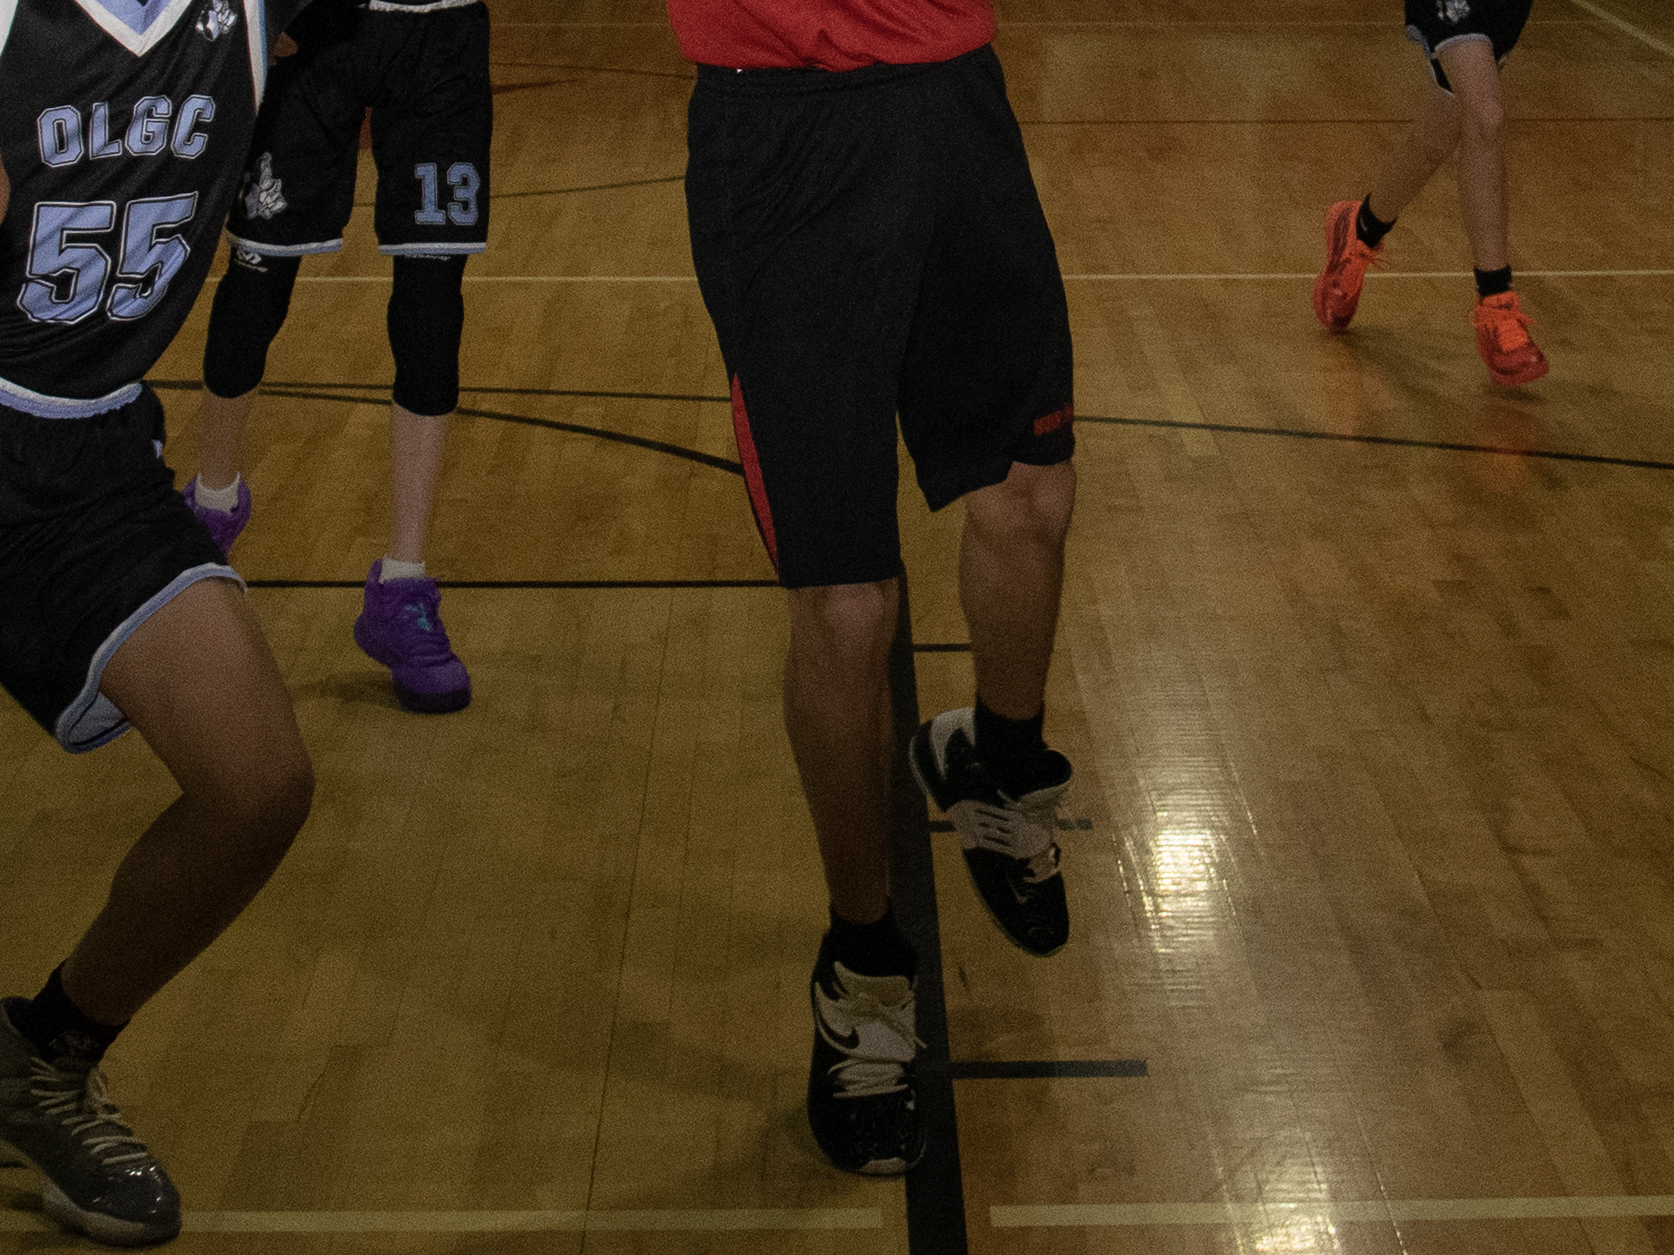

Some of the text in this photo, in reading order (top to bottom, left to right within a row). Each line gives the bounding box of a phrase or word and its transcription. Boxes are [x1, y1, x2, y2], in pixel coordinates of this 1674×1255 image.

[37, 95, 216, 168] OLGC
[414, 162, 480, 226] 13
[17, 191, 199, 324] 55
